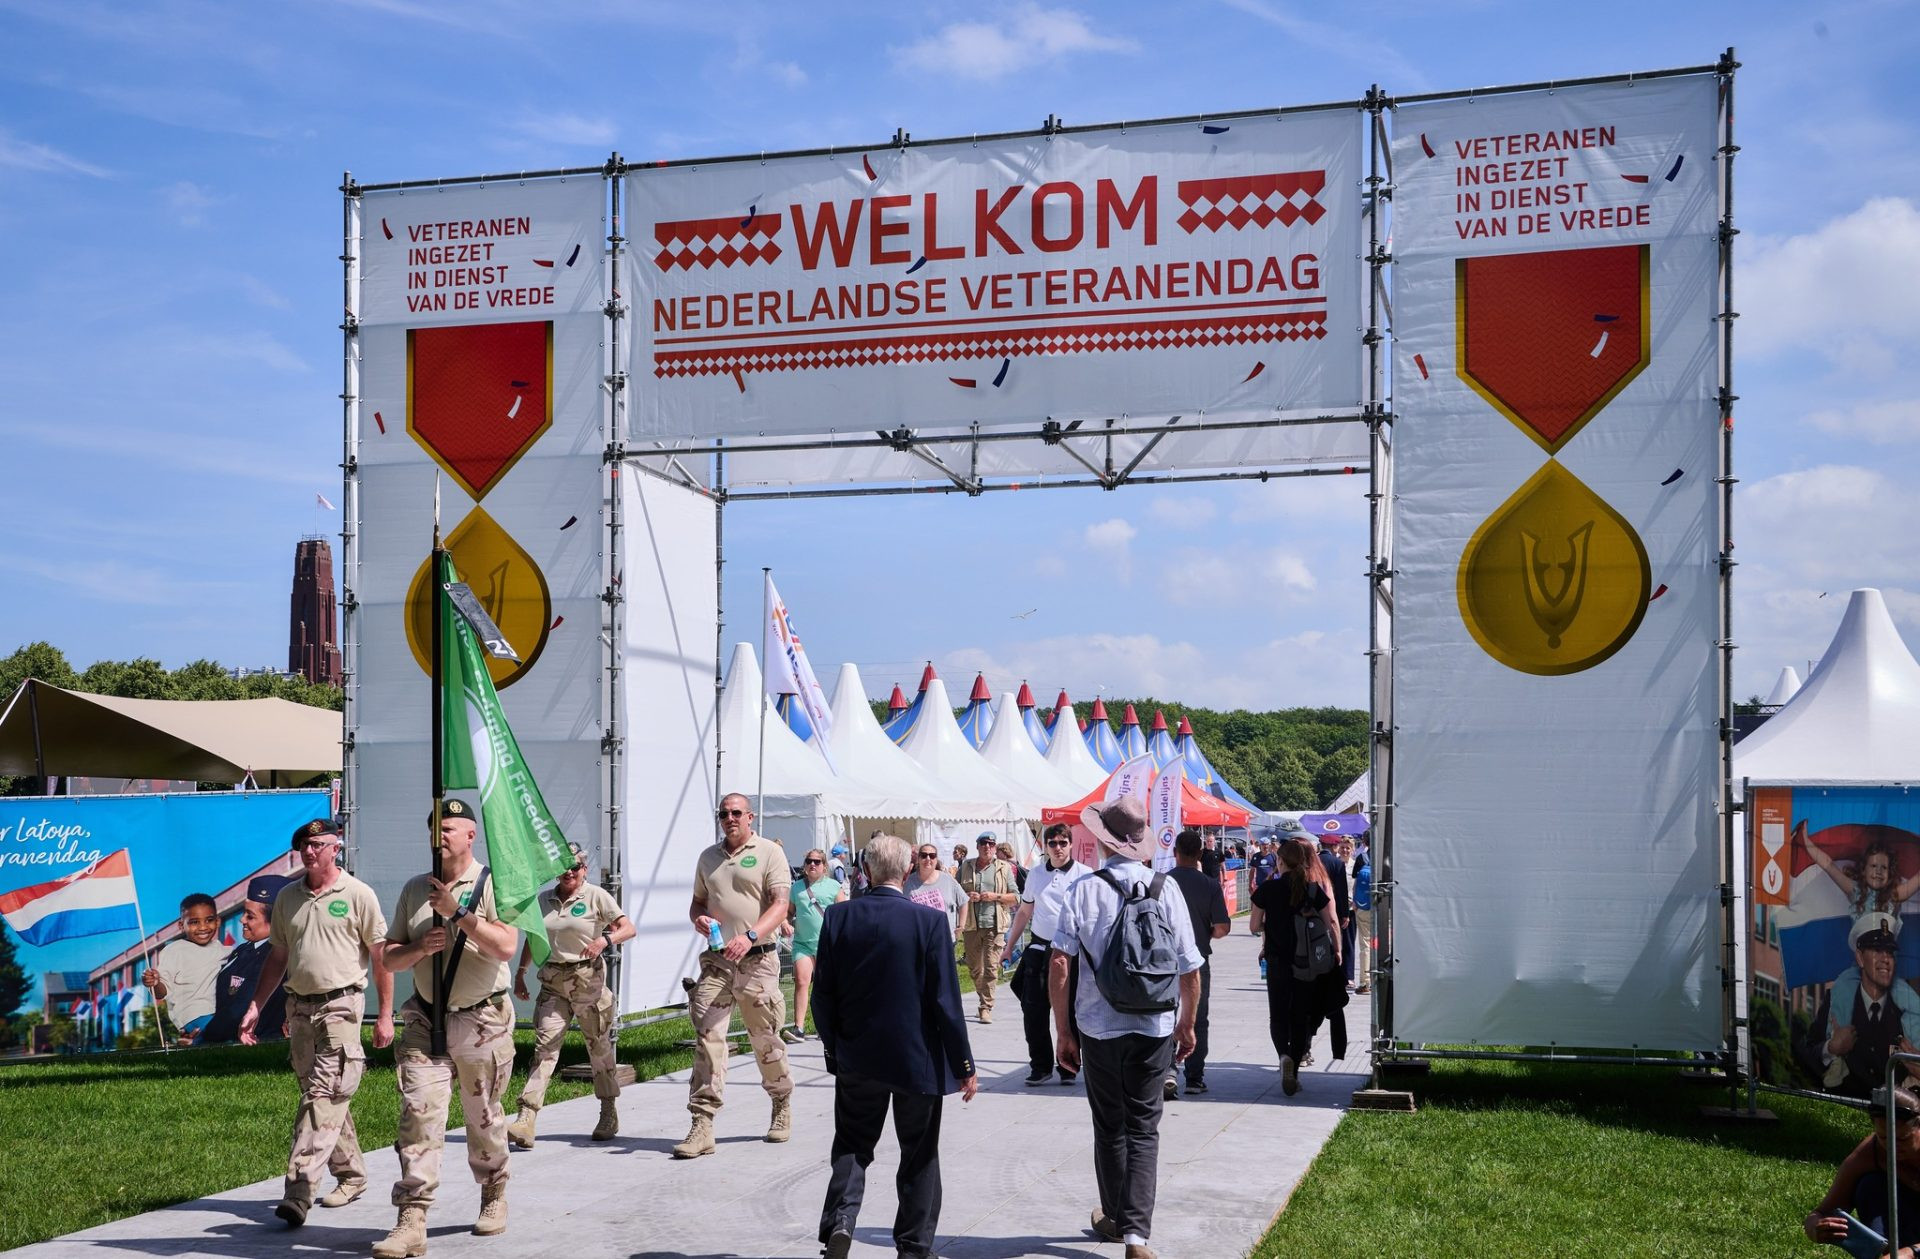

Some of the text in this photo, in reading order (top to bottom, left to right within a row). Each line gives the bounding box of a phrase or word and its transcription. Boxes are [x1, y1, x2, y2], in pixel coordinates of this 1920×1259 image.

[1455, 126, 1616, 159] VETERANEN
[1457, 157, 1569, 186] INGEZET
[1457, 183, 1588, 213] IN DIENST
[408, 217, 531, 242] VETERANEN
[790, 175, 1158, 271] WELKOM
[1455, 205, 1650, 240] VAN DE VREDE
[408, 243, 495, 266] INGEZET
[408, 265, 509, 289] IN DIENST
[653, 253, 1319, 332] NEDERLANDSE VETERANENDAG
[407, 287, 554, 313] VAN DE VREDE
[508, 770, 561, 862] Freedom
[1161, 776, 1170, 824] nuldelijns
[16, 817, 91, 850] Latoya,
